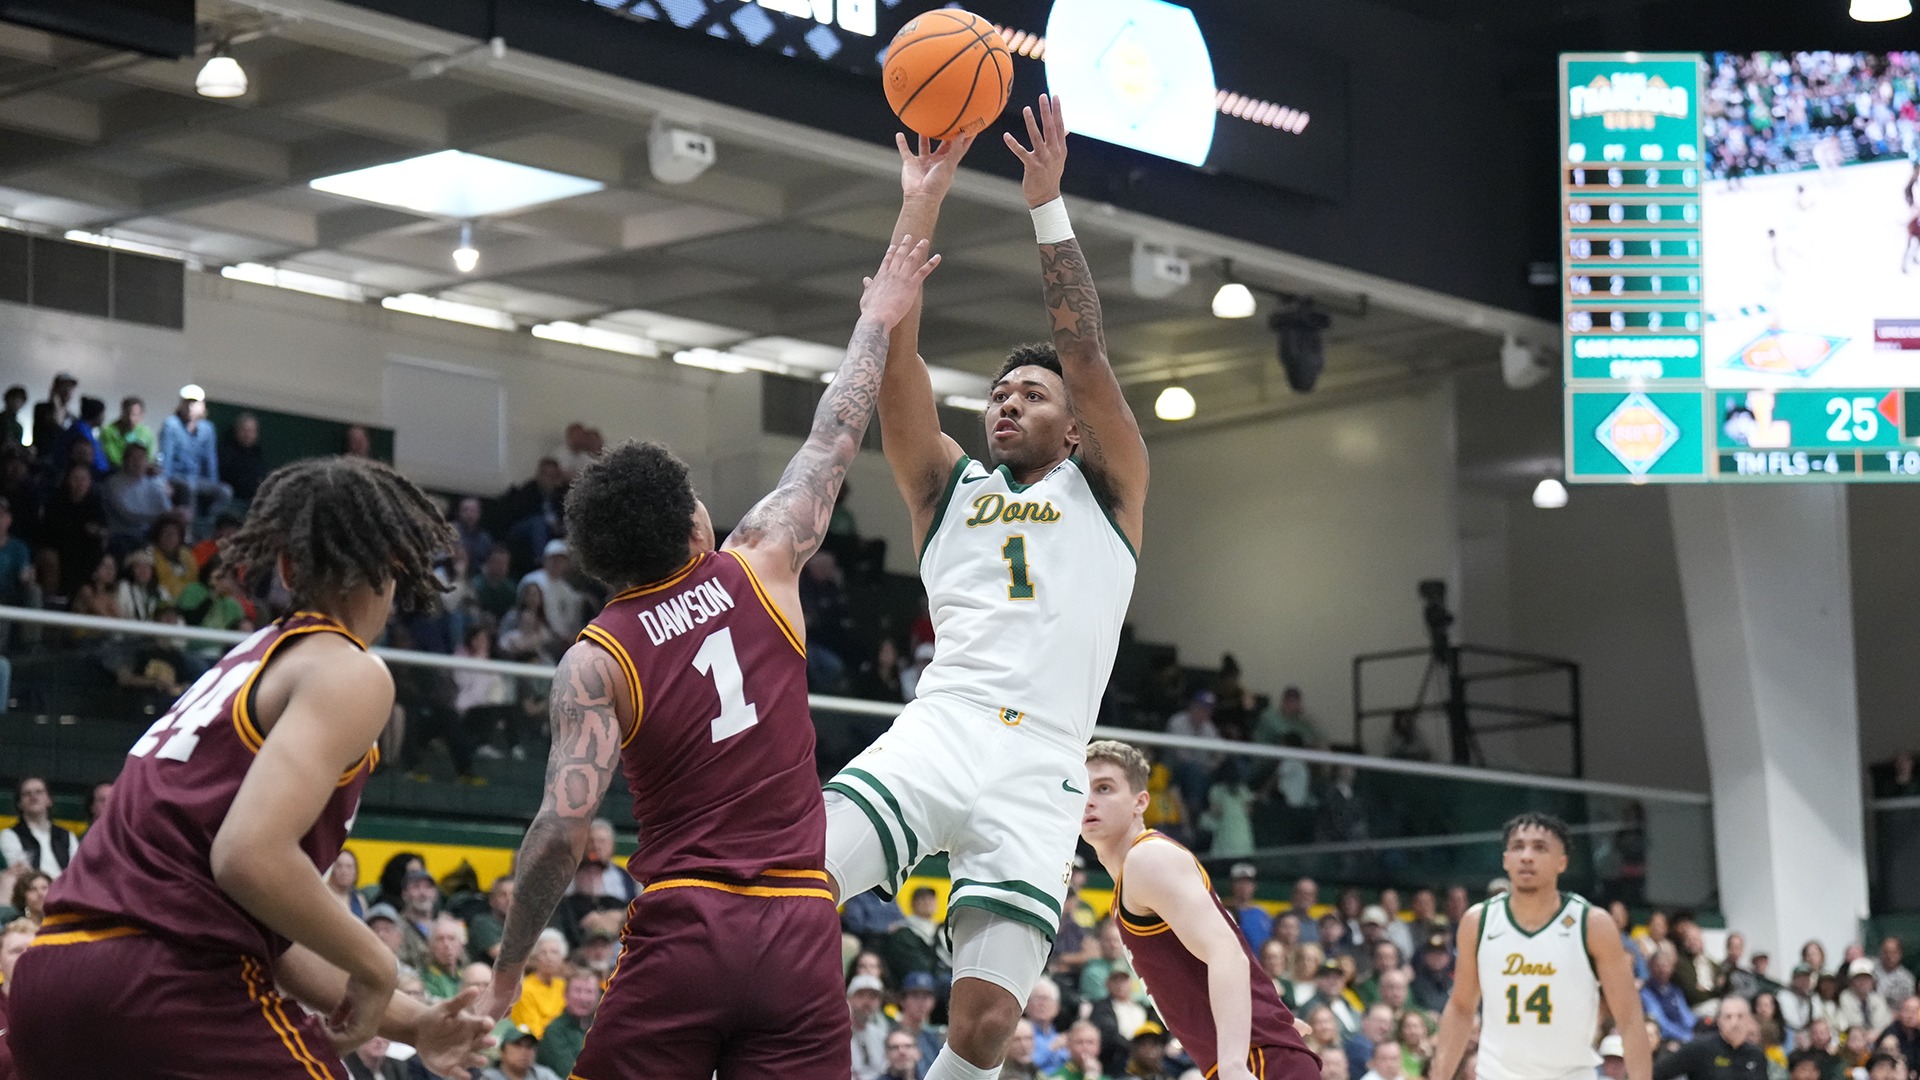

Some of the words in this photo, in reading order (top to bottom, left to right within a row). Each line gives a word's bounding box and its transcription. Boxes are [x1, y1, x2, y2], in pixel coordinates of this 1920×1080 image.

[1646, 168, 1659, 188] 2
[1610, 275, 1625, 295] 2
[1826, 397, 1878, 441] 25
[966, 493, 1061, 528] Dons
[1001, 534, 1035, 601] 1
[637, 576, 735, 647] DAWSON
[691, 626, 759, 743] 1
[1501, 953, 1557, 976] Dons
[1505, 983, 1552, 1025] 14
